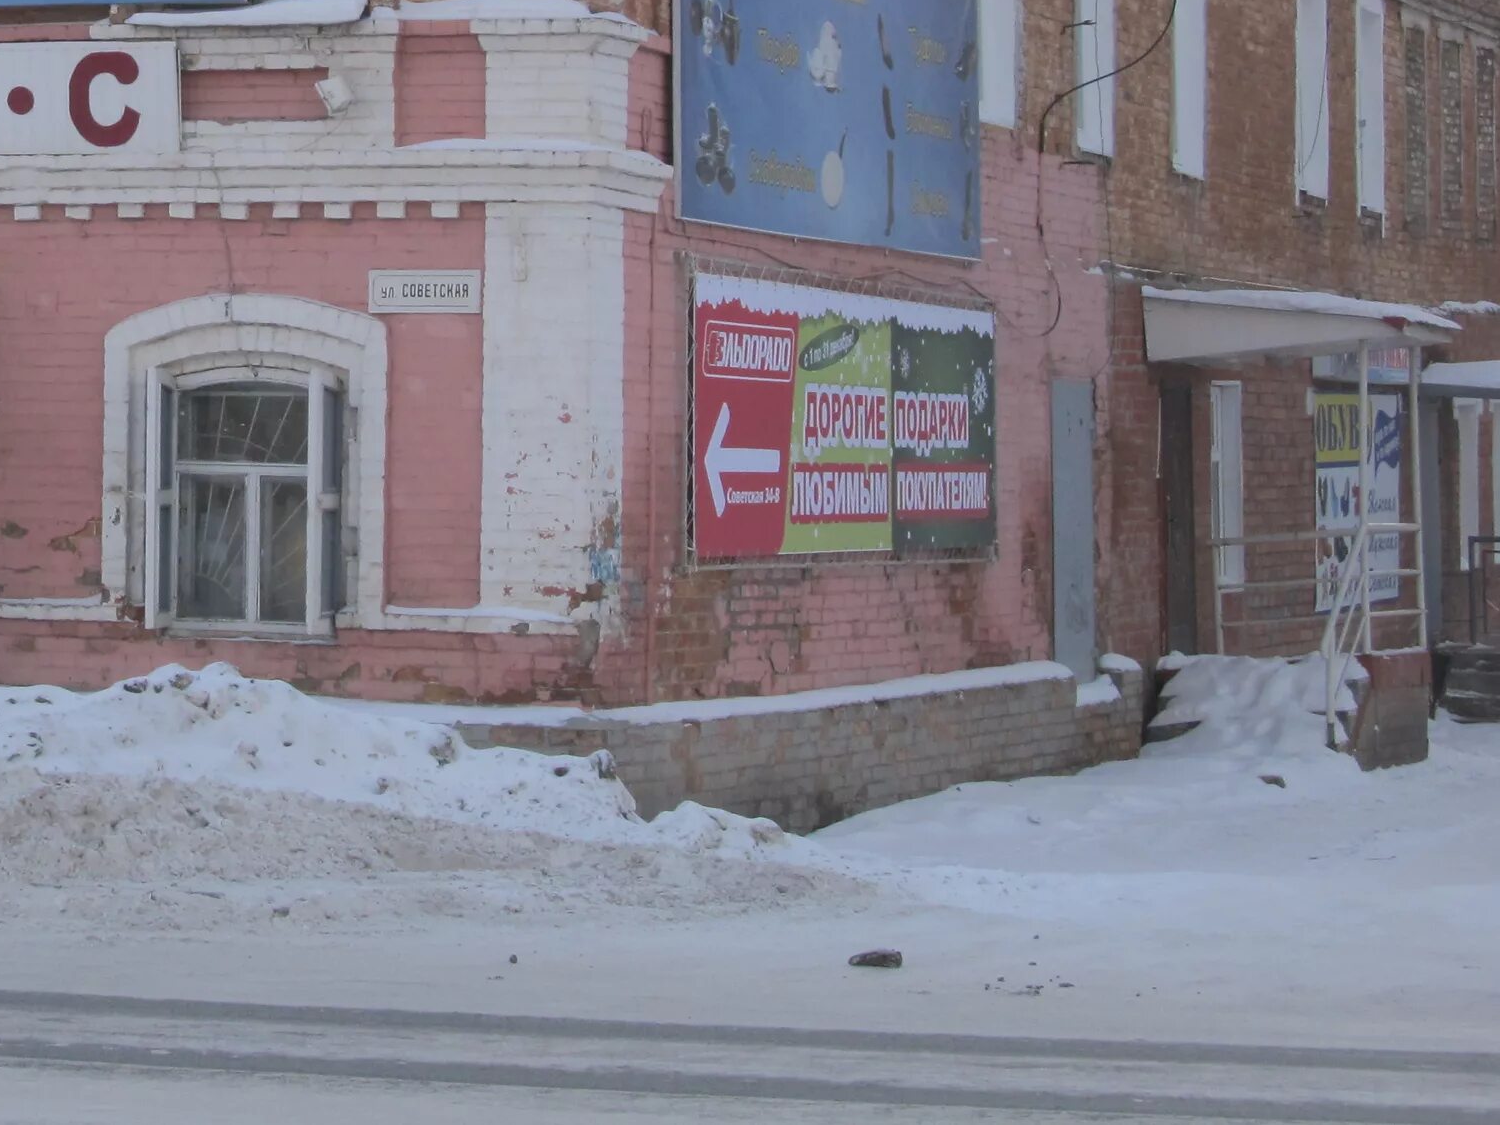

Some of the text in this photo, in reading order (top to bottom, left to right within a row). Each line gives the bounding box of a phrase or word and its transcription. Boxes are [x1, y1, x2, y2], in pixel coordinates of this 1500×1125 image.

[402, 284, 469, 298] СОВЕТСКАЯ
[804, 391, 968, 448] ДОРОГИЕ ПОДАРКИ
[727, 488, 763, 503] Советская
[792, 471, 987, 516] ЛЮБИМЫМ ПОКУПАТЕЛЯМ!
